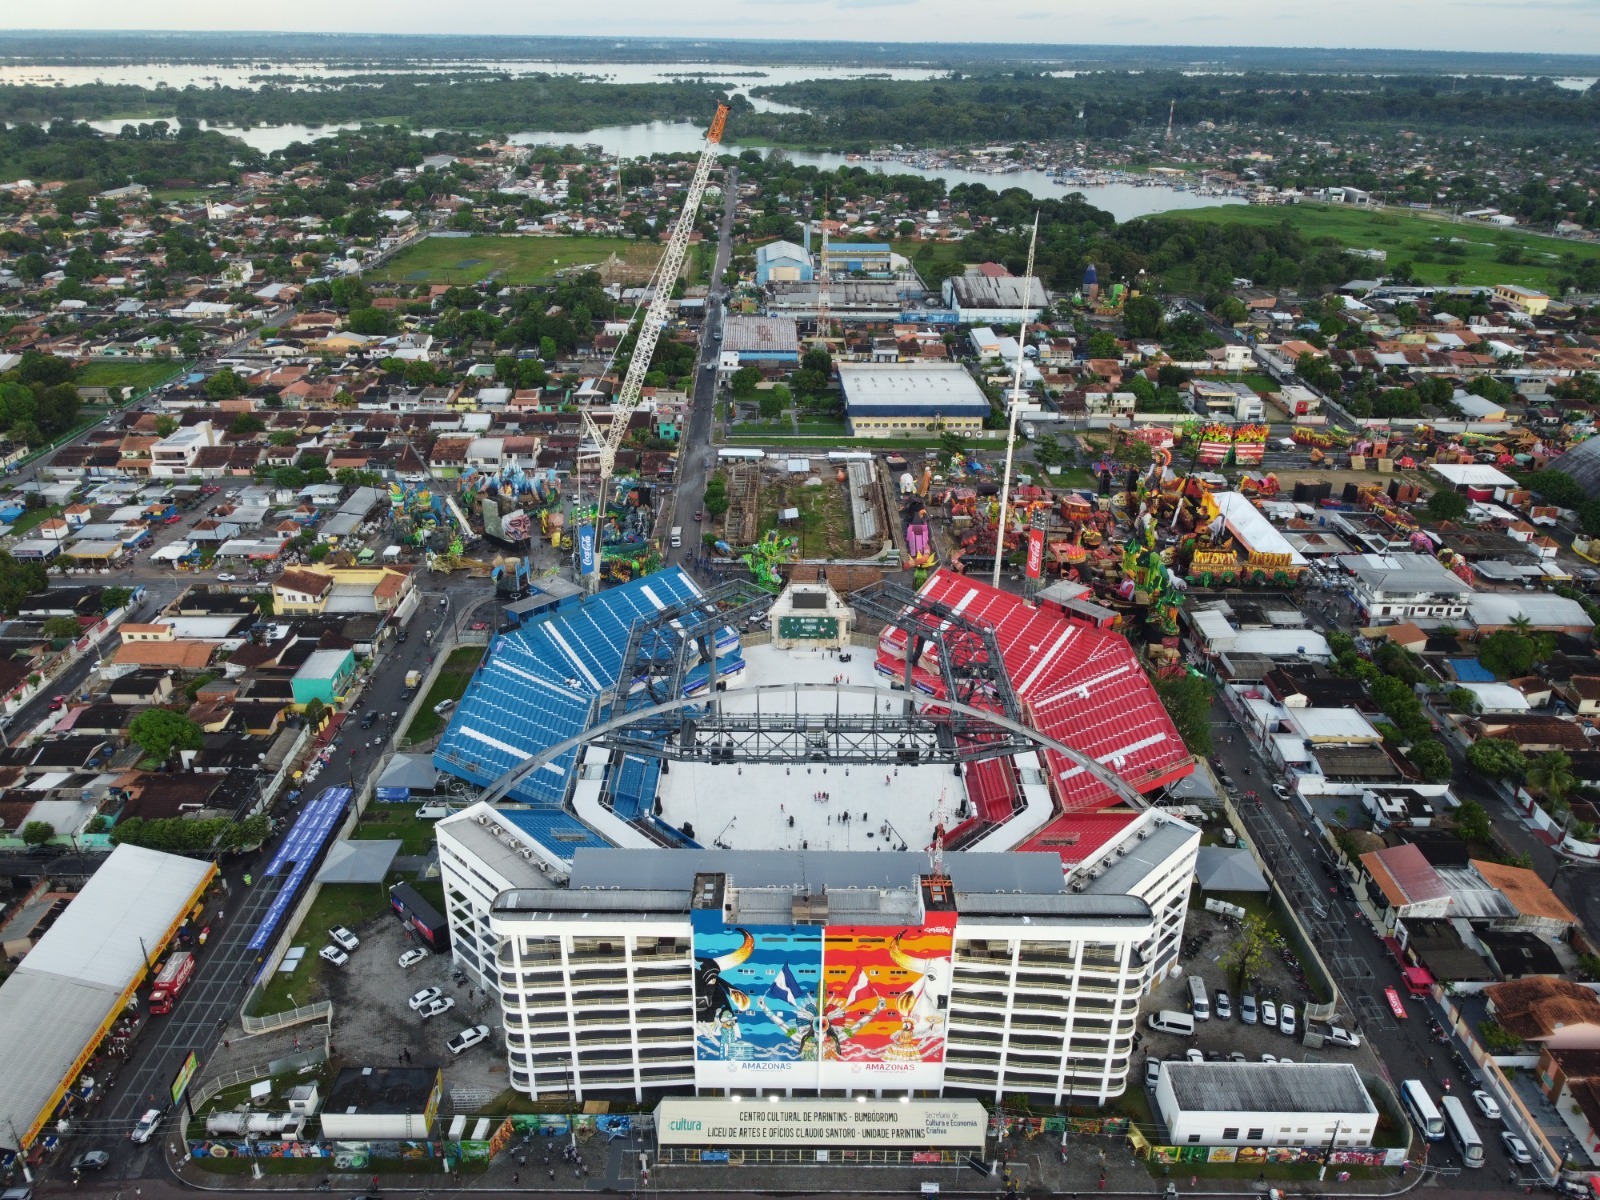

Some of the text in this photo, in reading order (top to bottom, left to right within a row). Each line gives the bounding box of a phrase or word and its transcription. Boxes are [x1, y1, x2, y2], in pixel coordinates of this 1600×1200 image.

[581, 535, 593, 566] Coca-Cola
[1029, 537, 1041, 571] Coca-Cola
[742, 1062, 792, 1070] AMAZONAS
[865, 1063, 915, 1071] AMAZONAS
[739, 1111, 766, 1122] CENTRO
[767, 1111, 802, 1122] CULTURAL
[803, 1111, 812, 1122] DE
[814, 1111, 848, 1123] PARINTINS
[854, 1110, 898, 1123] BUMBÓDROMO
[952, 1111, 959, 1119] de
[670, 1117, 702, 1131] cultura
[925, 1119, 945, 1127] Cultura
[950, 1119, 977, 1127] Economia
[707, 1127, 727, 1138] LICEU
[728, 1127, 737, 1138] DE
[739, 1127, 761, 1138] ARTES
[762, 1127, 767, 1138] E
[769, 1126, 795, 1138] OFÍCIOS
[796, 1128, 823, 1138] CLAUDIO
[825, 1128, 856, 1138] SANTORO
[862, 1128, 890, 1139] UNIDADE
[891, 1129, 926, 1139] PARINTINS
[926, 1127, 947, 1135] Criativa
